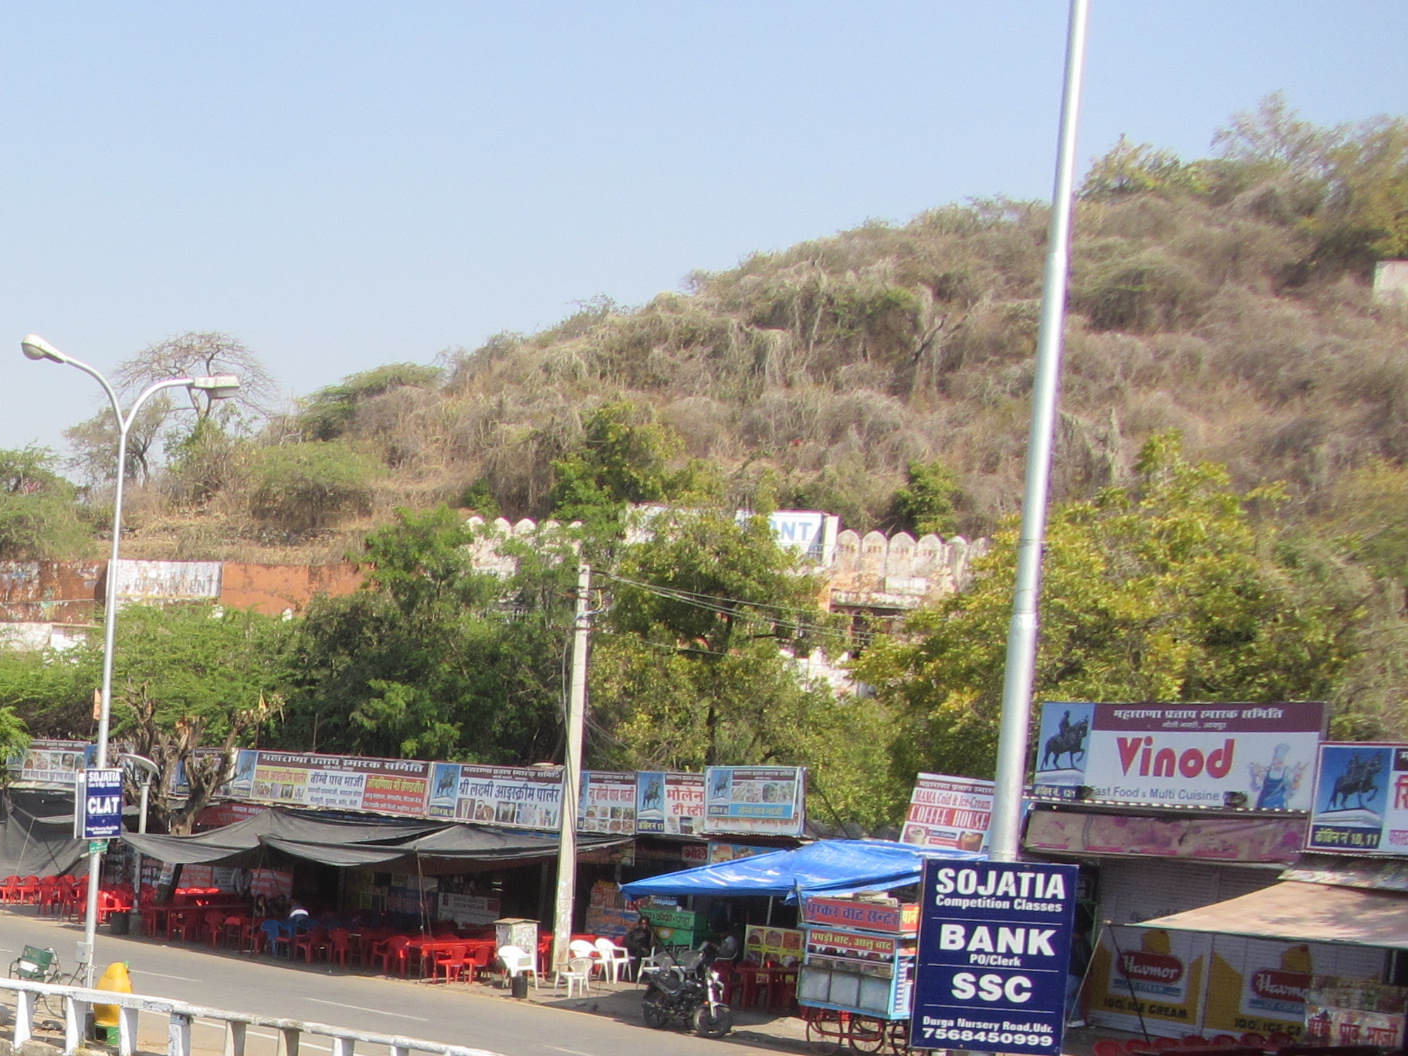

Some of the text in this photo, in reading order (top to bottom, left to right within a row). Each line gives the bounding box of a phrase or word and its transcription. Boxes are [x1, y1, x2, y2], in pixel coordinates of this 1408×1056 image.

[1116, 735, 1236, 779] Vinod
[88, 771, 121, 782] SOJATIA
[537, 784, 560, 803] पार्लर
[667, 786, 705, 802] भोलेन
[1113, 786, 1140, 799] Food
[1149, 787, 1176, 800] Multi
[1178, 789, 1220, 802] Cuisine
[88, 797, 120, 814] CLAT
[687, 802, 705, 817] स्टॉ
[910, 805, 989, 831] COFFEE HOUSE
[936, 868, 1066, 900] SOJATIA
[936, 895, 1063, 912] Competition Classes
[939, 924, 1057, 956] BANK
[970, 953, 1021, 967] PO/Clerk
[951, 972, 1032, 1003] SSC
[1257, 973, 1310, 1000] Havmo
[1148, 1004, 1188, 1019] CREAM
[922, 1015, 954, 1028] Durga
[957, 1018, 1000, 1031] Nursery
[922, 1028, 1053, 1047] 7568450999
